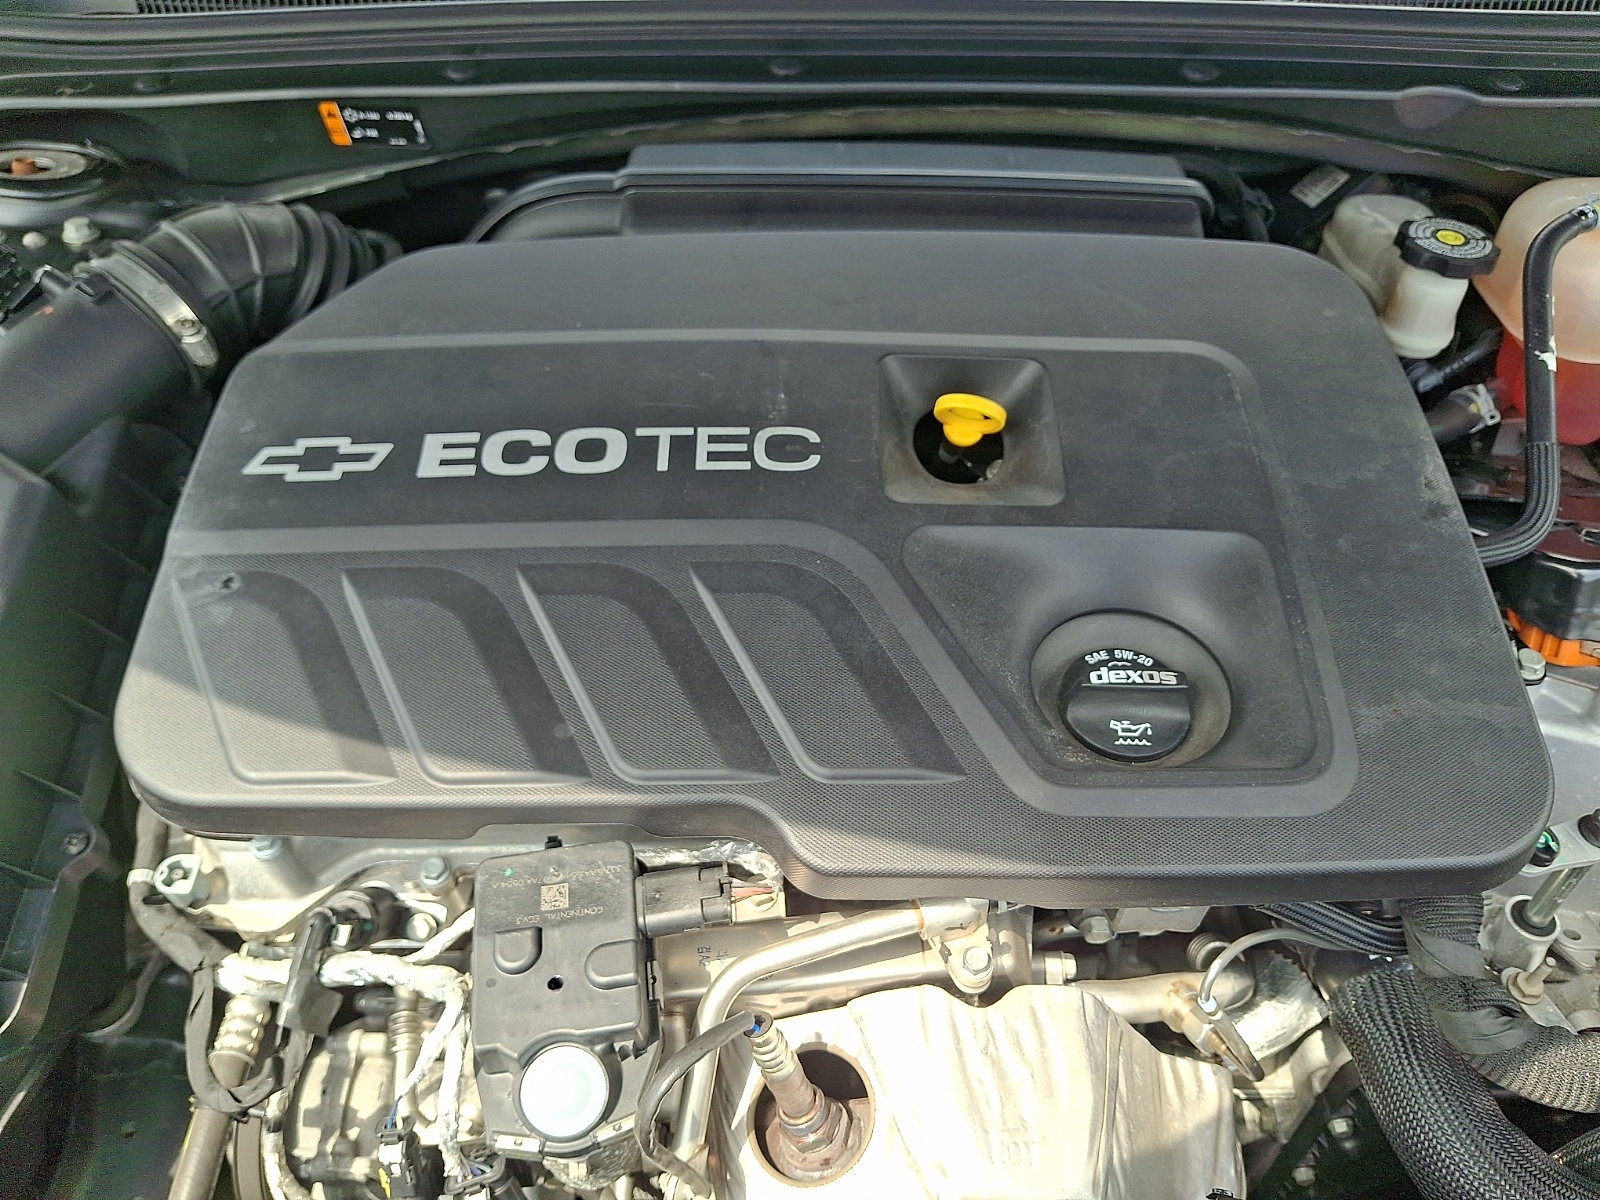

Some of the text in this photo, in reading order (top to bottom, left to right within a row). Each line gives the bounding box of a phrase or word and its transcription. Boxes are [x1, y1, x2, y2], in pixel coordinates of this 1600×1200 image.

[415, 426, 822, 478] ECOTEC
[1084, 650, 1154, 667] SAE 5W-20
[1089, 667, 1179, 685] dexos
[545, 906, 604, 919] CONTINENTAL
